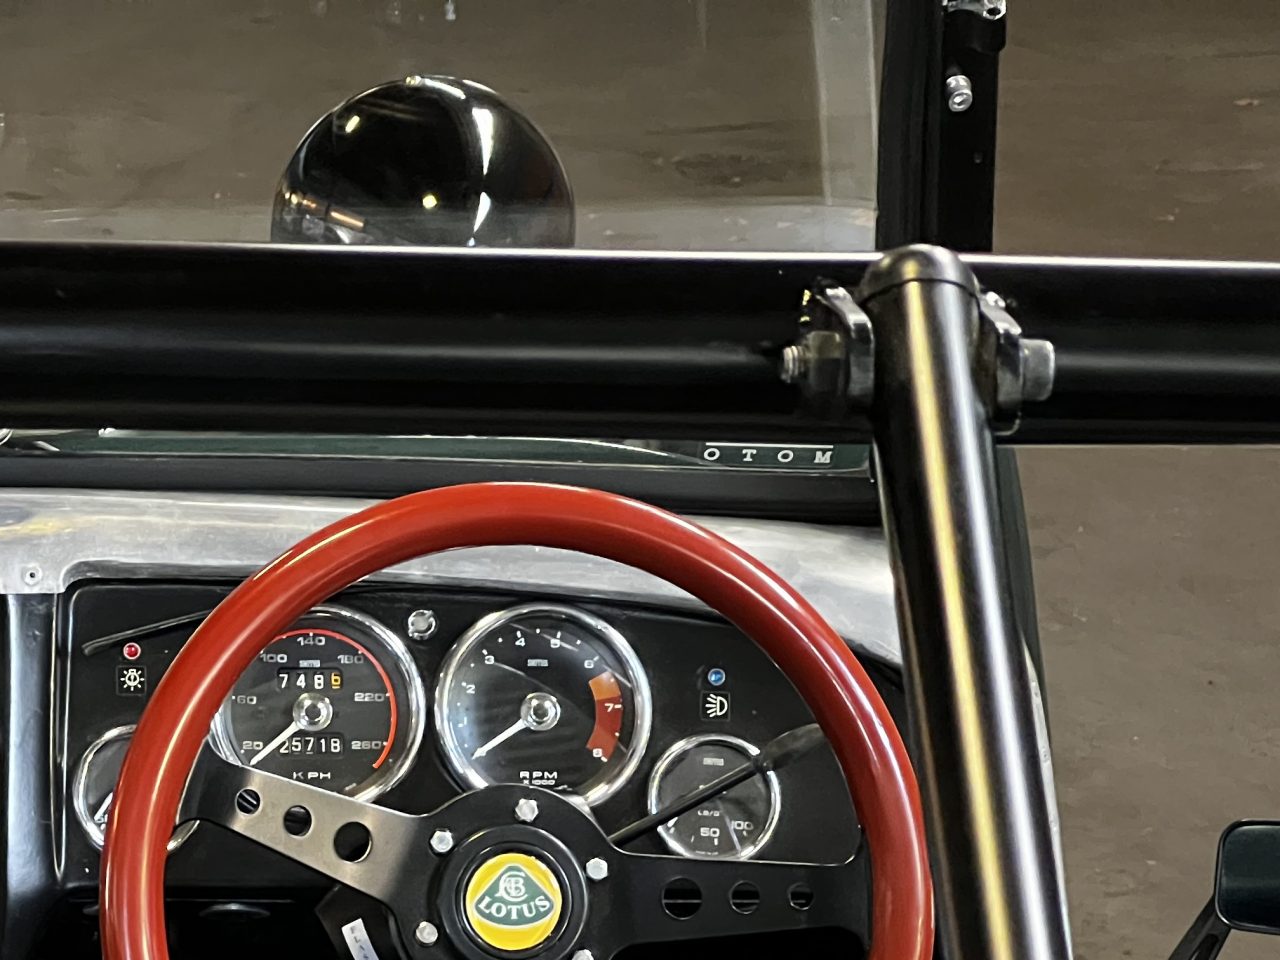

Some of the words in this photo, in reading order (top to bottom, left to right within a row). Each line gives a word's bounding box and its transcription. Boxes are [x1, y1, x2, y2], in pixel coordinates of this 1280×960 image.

[297, 636, 326, 646] 140
[514, 637, 525, 647] 4
[260, 653, 287, 663] 100
[484, 655, 495, 665] 3
[466, 684, 476, 694] 2
[236, 695, 257, 705] 60
[354, 692, 385, 702] 220
[604, 702, 614, 712] 7
[242, 740, 264, 750] 20
[279, 737, 341, 754] 25718
[351, 740, 382, 750] 260
[293, 771, 331, 780] KPH
[519, 771, 558, 779] RPM
[700, 827, 720, 837] 50
[477, 895, 551, 920] LOTUS
